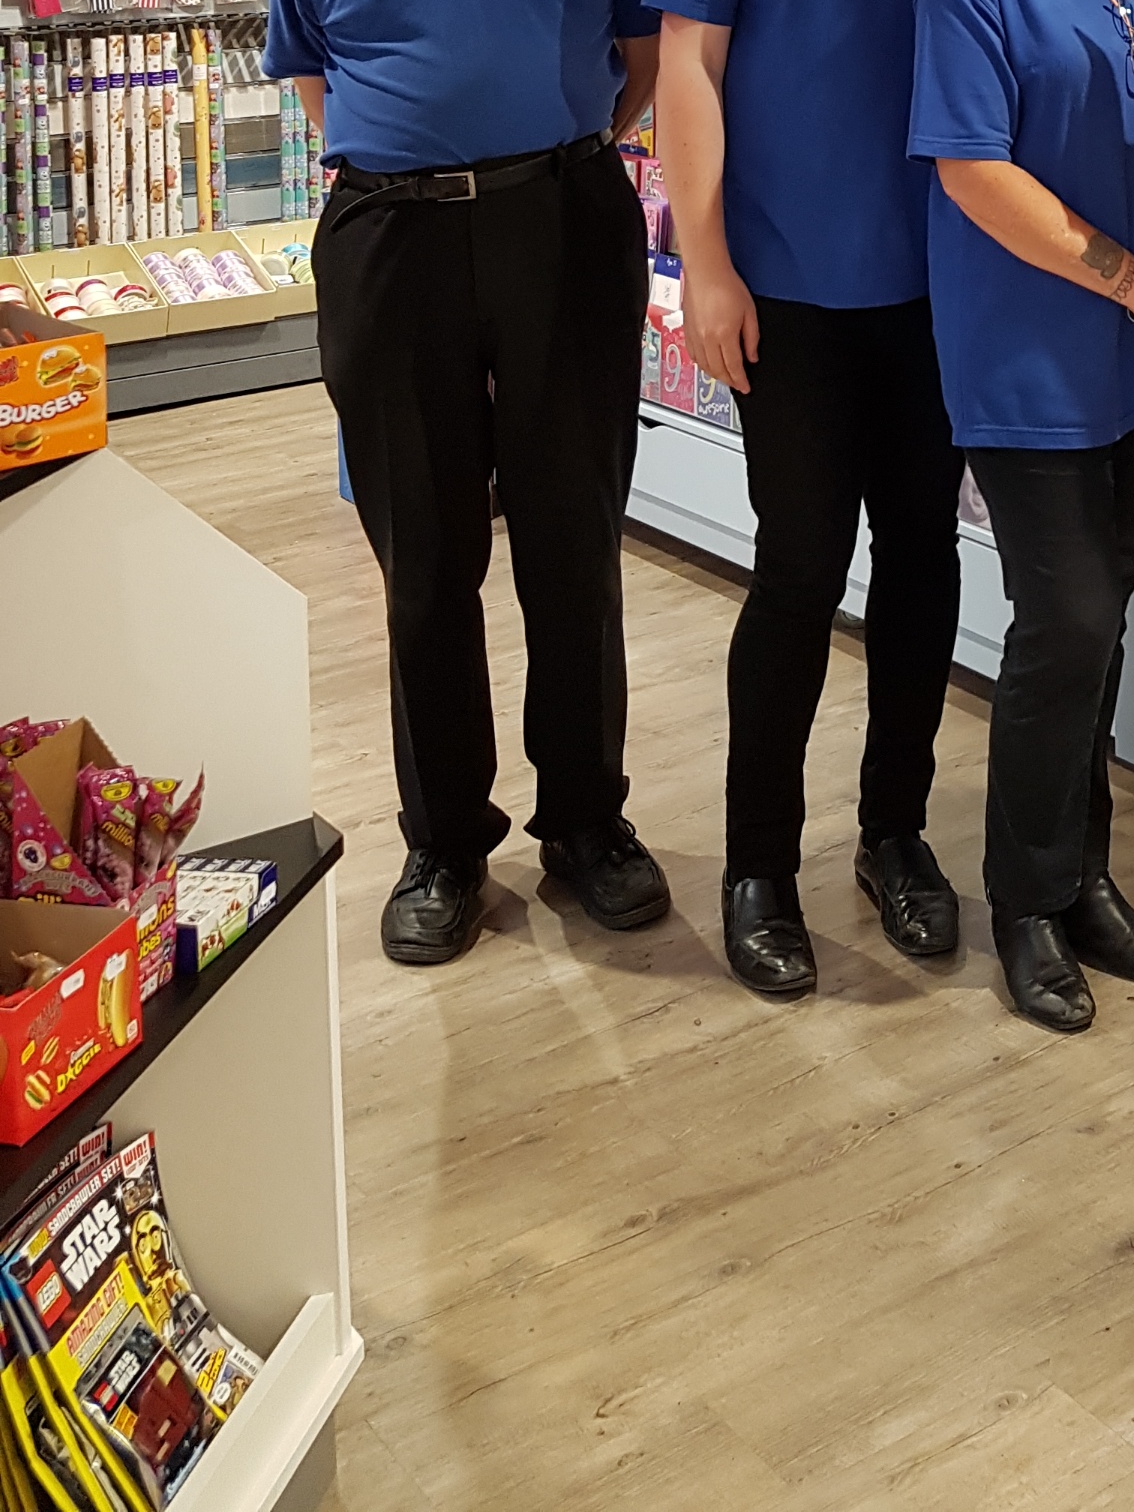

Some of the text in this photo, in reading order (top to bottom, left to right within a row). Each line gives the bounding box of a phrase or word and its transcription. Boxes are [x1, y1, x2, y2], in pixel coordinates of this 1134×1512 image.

[664, 343, 682, 393] 9
[0, 390, 88, 428] BURGER
[122, 1139, 149, 1167] WIN!
[47, 1176, 102, 1237] SANDCRAWLER
[101, 1157, 122, 1183] SET!
[60, 1198, 119, 1276] STAR
[63, 1214, 121, 1293] WARS
[37, 1271, 62, 1315] LEGO
[66, 1296, 106, 1358] AMAZING
[102, 1271, 126, 1309] GIFT!
[107, 1349, 136, 1388] STAR
